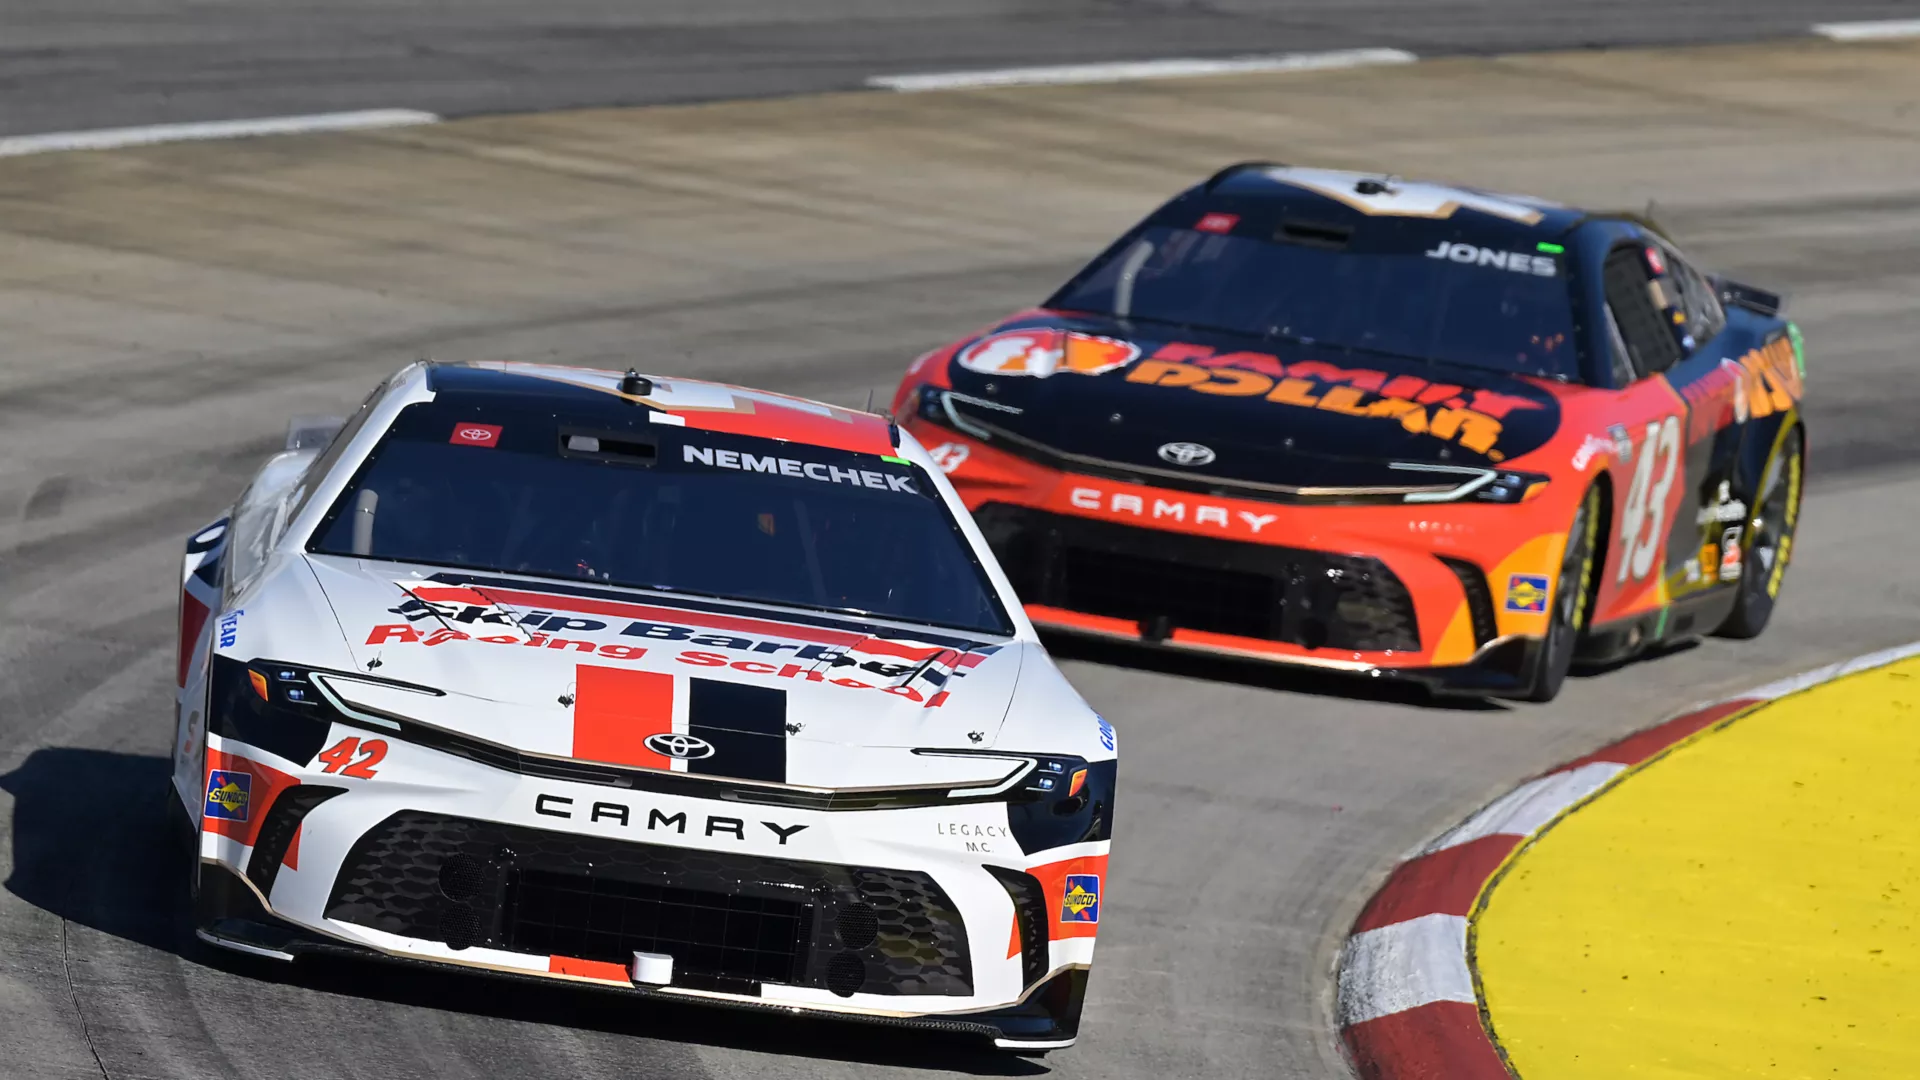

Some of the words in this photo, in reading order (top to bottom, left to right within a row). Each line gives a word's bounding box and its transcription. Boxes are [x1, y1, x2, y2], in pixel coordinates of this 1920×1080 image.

[1426, 241, 1557, 276] JONES
[682, 444, 918, 495] NEMECHEK
[1070, 486, 1279, 533] CAMRY
[1616, 415, 1681, 585] 43
[318, 735, 389, 781] 42
[210, 789, 249, 805] SUNOCO
[534, 793, 811, 845] CAMRY
[937, 822, 1008, 838] LEGACY
[1065, 894, 1094, 906] SUNOCO
